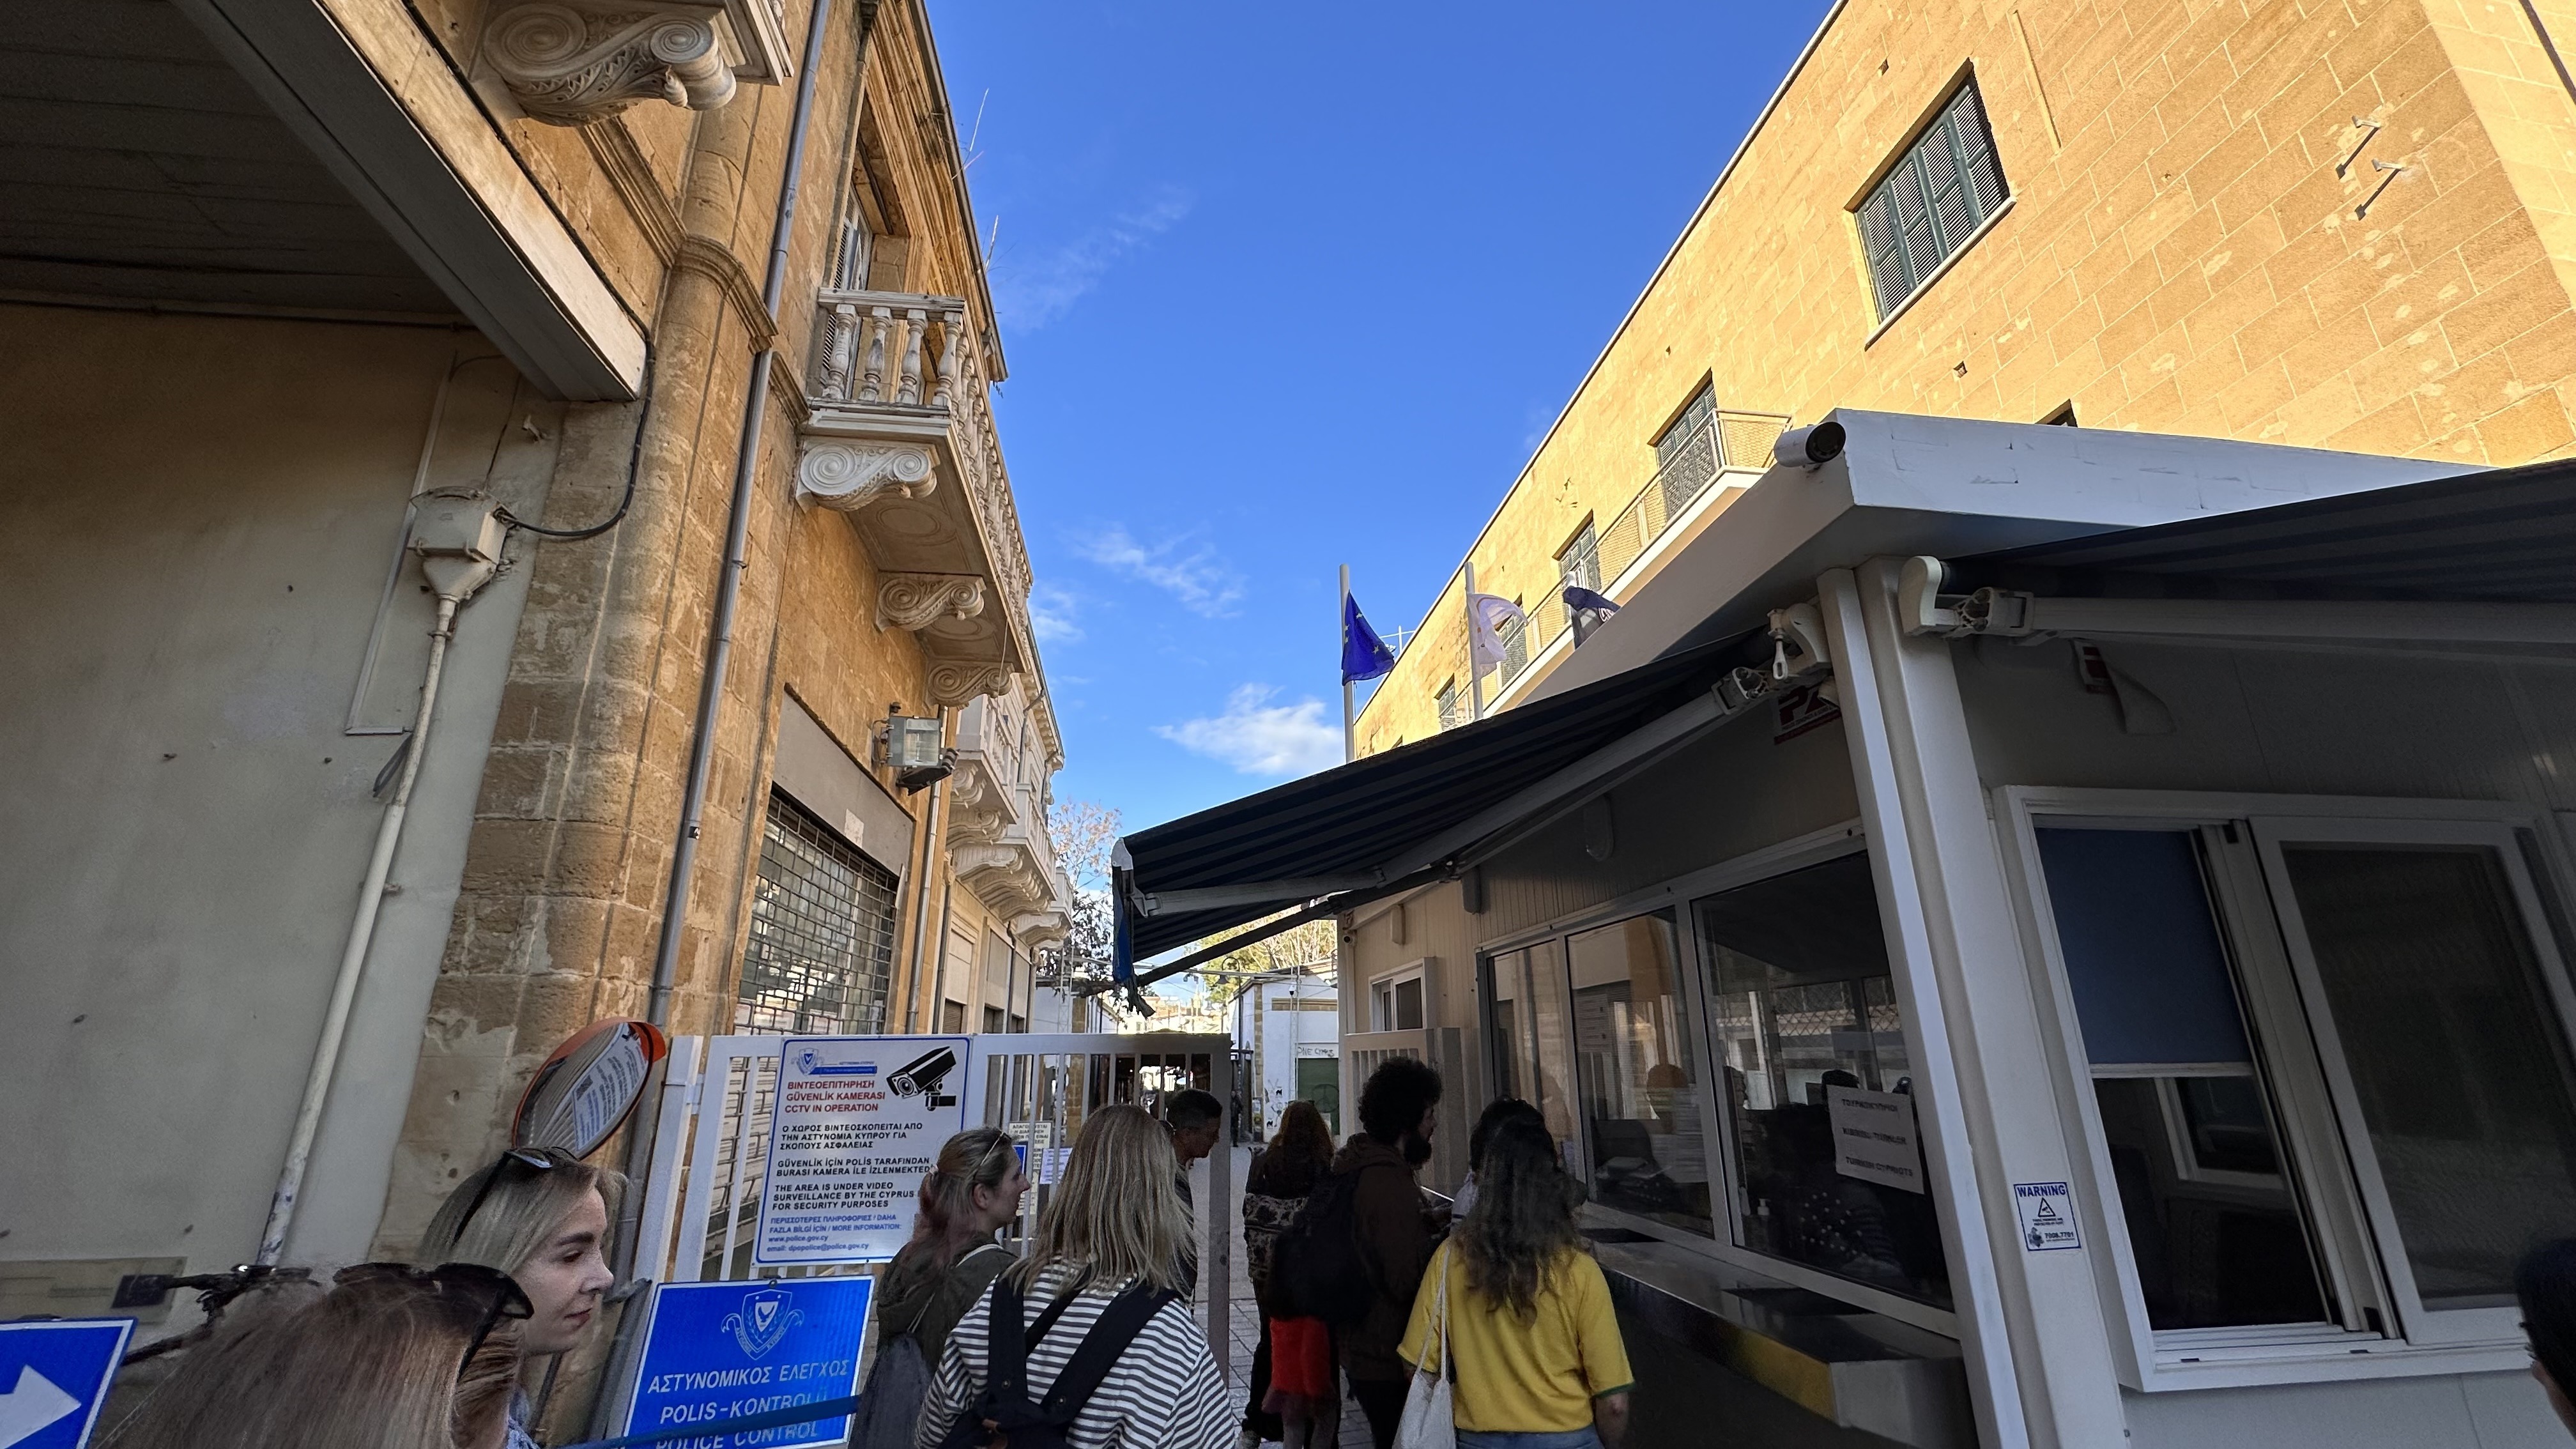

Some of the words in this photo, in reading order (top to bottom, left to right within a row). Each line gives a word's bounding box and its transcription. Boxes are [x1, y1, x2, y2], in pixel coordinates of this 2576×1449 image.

[788, 1080, 875, 1089] ΒΙΝΤΕΟΕΠΙΤΗΡΗΣΗ
[786, 1091, 834, 1101] GÜVENLİK
[836, 1092, 885, 1100] KAMERASI
[785, 1105, 811, 1113] CCTV
[825, 1103, 878, 1112] OPERATION
[824, 1123, 901, 1131] ΒΙΝΤΕΟΣΚΟΠΕΙΤΑΙ
[778, 1158, 822, 1167] GÜVENLİK
[825, 1157, 843, 1167] İÇİN
[846, 1156, 871, 1165] POLİS
[853, 1166, 866, 1174] İLE
[2017, 1184, 2066, 1197] WARNING
[774, 1192, 841, 1201] SURVEILLANCE
[647, 1367, 772, 1393] ΑΣΤΥΝΟΜΙΚΟΣ
[779, 1360, 849, 1381] ΕΛΕΓΧΟΣ
[735, 1421, 817, 1446] CONTROL
